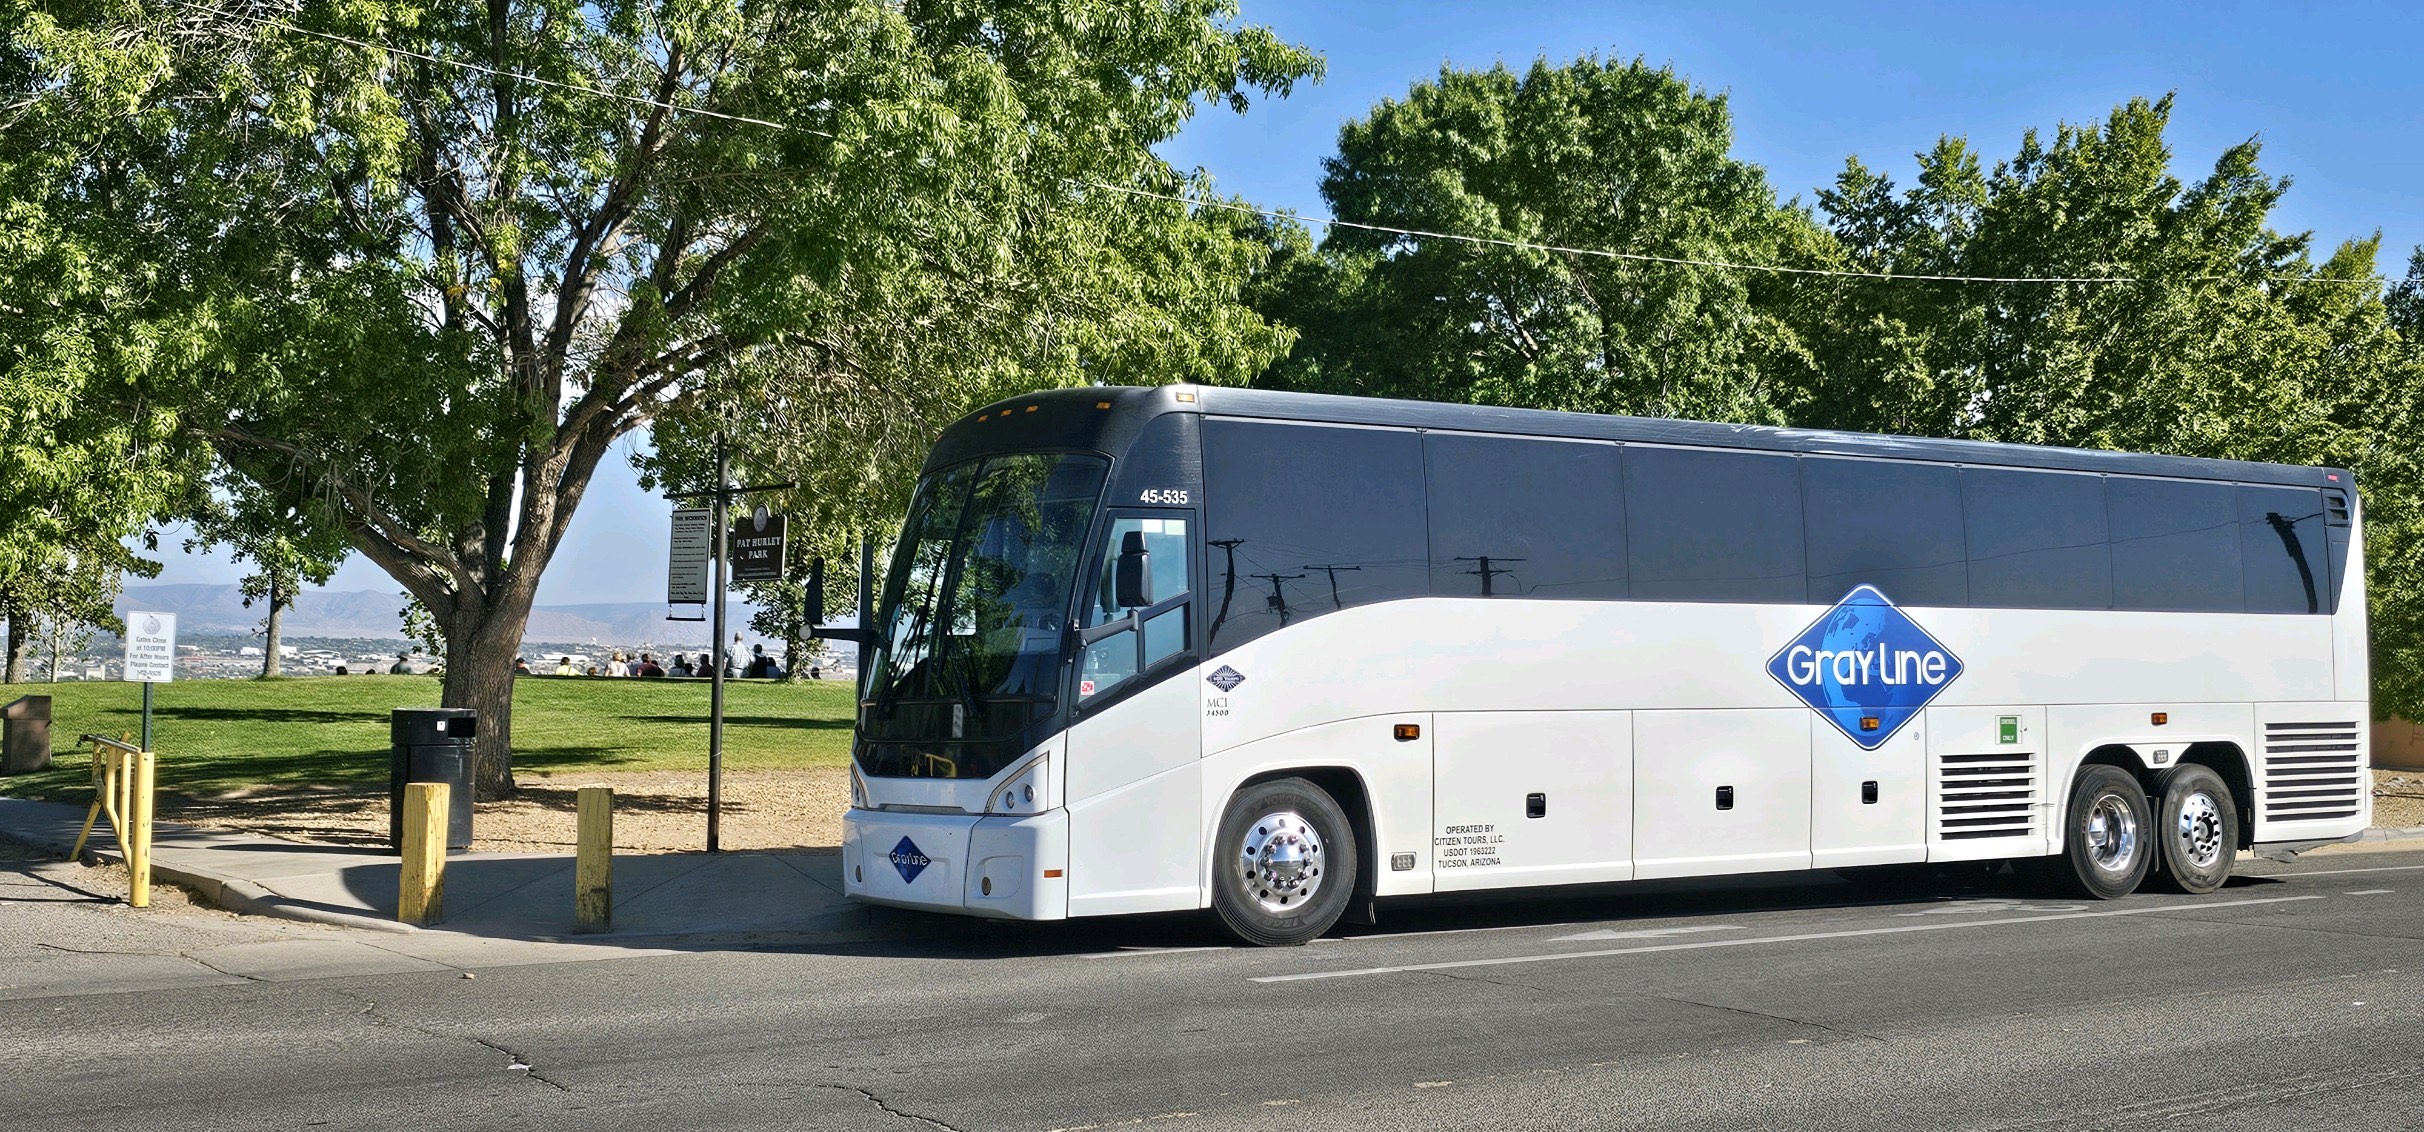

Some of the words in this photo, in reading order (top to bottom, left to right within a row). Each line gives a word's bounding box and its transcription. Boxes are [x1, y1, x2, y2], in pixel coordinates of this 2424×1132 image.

[1140, 489, 1188, 505] 45-535
[736, 538, 751, 548] PAT
[748, 549, 768, 559] PARK
[1207, 697, 1228, 708] MCI
[1446, 825, 1483, 834] OPERATED
[1485, 824, 1494, 833] BY
[1434, 837, 1461, 846] CITIZEN
[1463, 836, 1489, 845] TOURS,
[1443, 848, 1468, 857] USDOT
[1438, 859, 1469, 868] TUCSON,
[1470, 857, 1501, 867] ARIZONA
